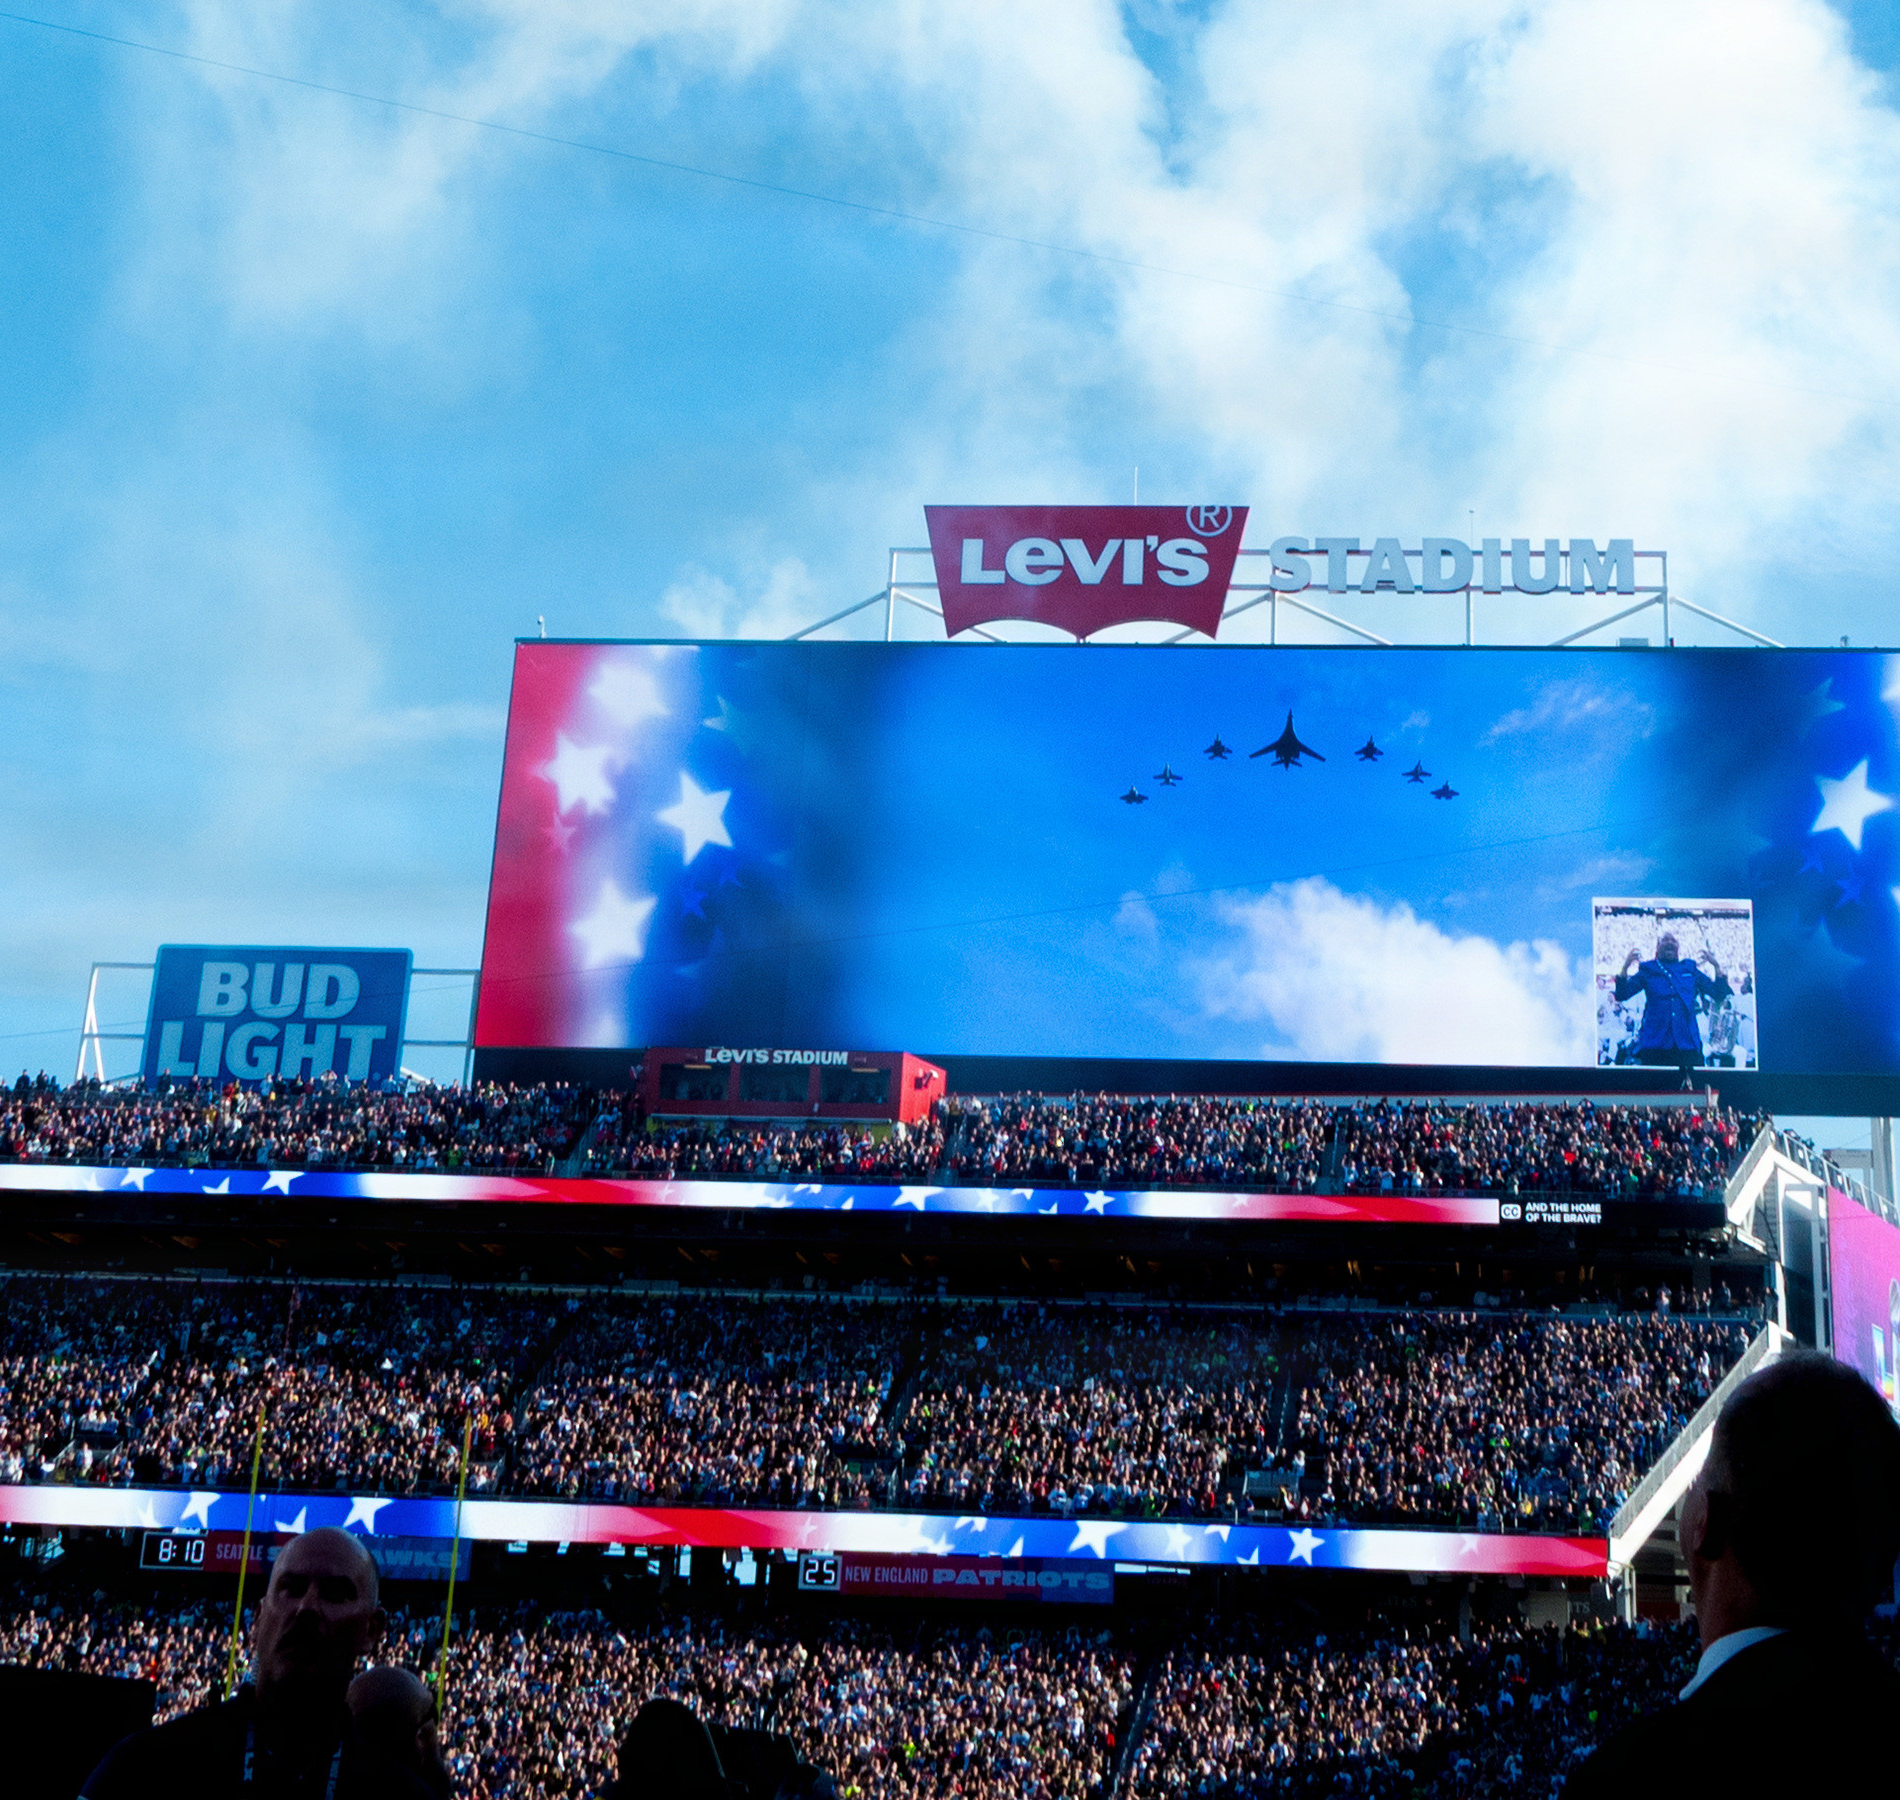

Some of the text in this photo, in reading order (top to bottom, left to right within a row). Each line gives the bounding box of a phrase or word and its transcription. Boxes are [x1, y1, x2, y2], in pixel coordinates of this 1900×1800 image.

[1268, 535, 1635, 595] STADIUM
[196, 961, 361, 1019] BUD
[156, 1020, 387, 1080] LIGHT
[772, 1049, 848, 1066] STADIUM
[1525, 1202, 1602, 1214] AND THE HOME
[1525, 1213, 1602, 1224] OF THE BRAVE?
[158, 1538, 205, 1564] 8:10
[267, 1544, 462, 1568] SAWKS
[806, 1558, 835, 1586] 25
[844, 1565, 1111, 1590] NEW ENGLAND PATRIOTS
